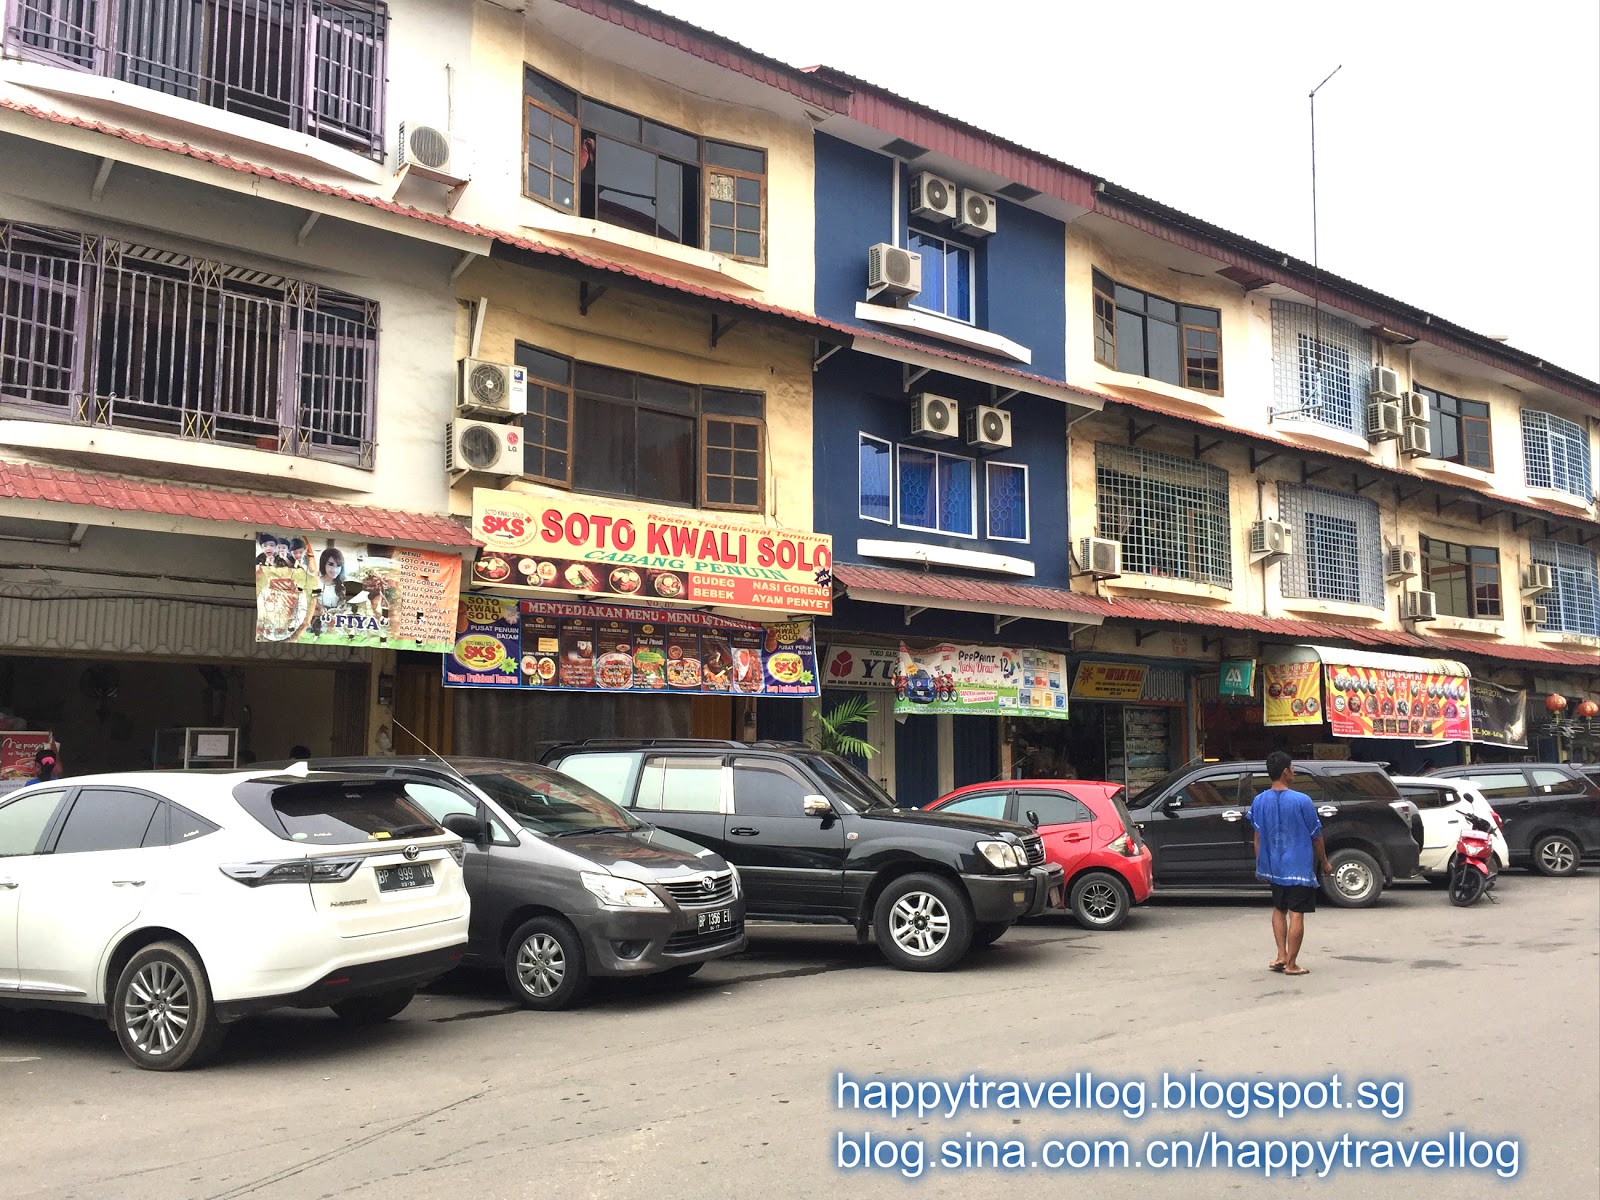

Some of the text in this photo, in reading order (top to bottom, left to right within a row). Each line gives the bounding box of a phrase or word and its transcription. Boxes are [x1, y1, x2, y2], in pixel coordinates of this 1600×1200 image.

[482, 515, 524, 537] SKS
[647, 514, 830, 544] Resep Tradisional Temurun
[540, 508, 832, 572] SOTO KWALI SOLO
[584, 550, 789, 581] CABANG PENUIN
[416, 580, 444, 588] GORENG
[692, 576, 830, 597] GUDEG NASI GORENG
[468, 597, 500, 606] SOTO
[693, 588, 830, 609] BEBEK AYAM PENYET
[466, 604, 501, 614] KWALI
[468, 612, 500, 620] SOLO
[528, 602, 623, 618] MENYEDIAKAN
[625, 608, 659, 620] MENU
[667, 612, 700, 624] MENU
[494, 626, 519, 634] PENUIN
[464, 646, 496, 660] SKS
[774, 661, 798, 674] SKS
[958, 660, 976, 675] Lucky
[976, 662, 995, 674] Draw
[1000, 658, 1009, 672] 12
[379, 865, 432, 884] BP 999 VK
[699, 915, 705, 927] BP
